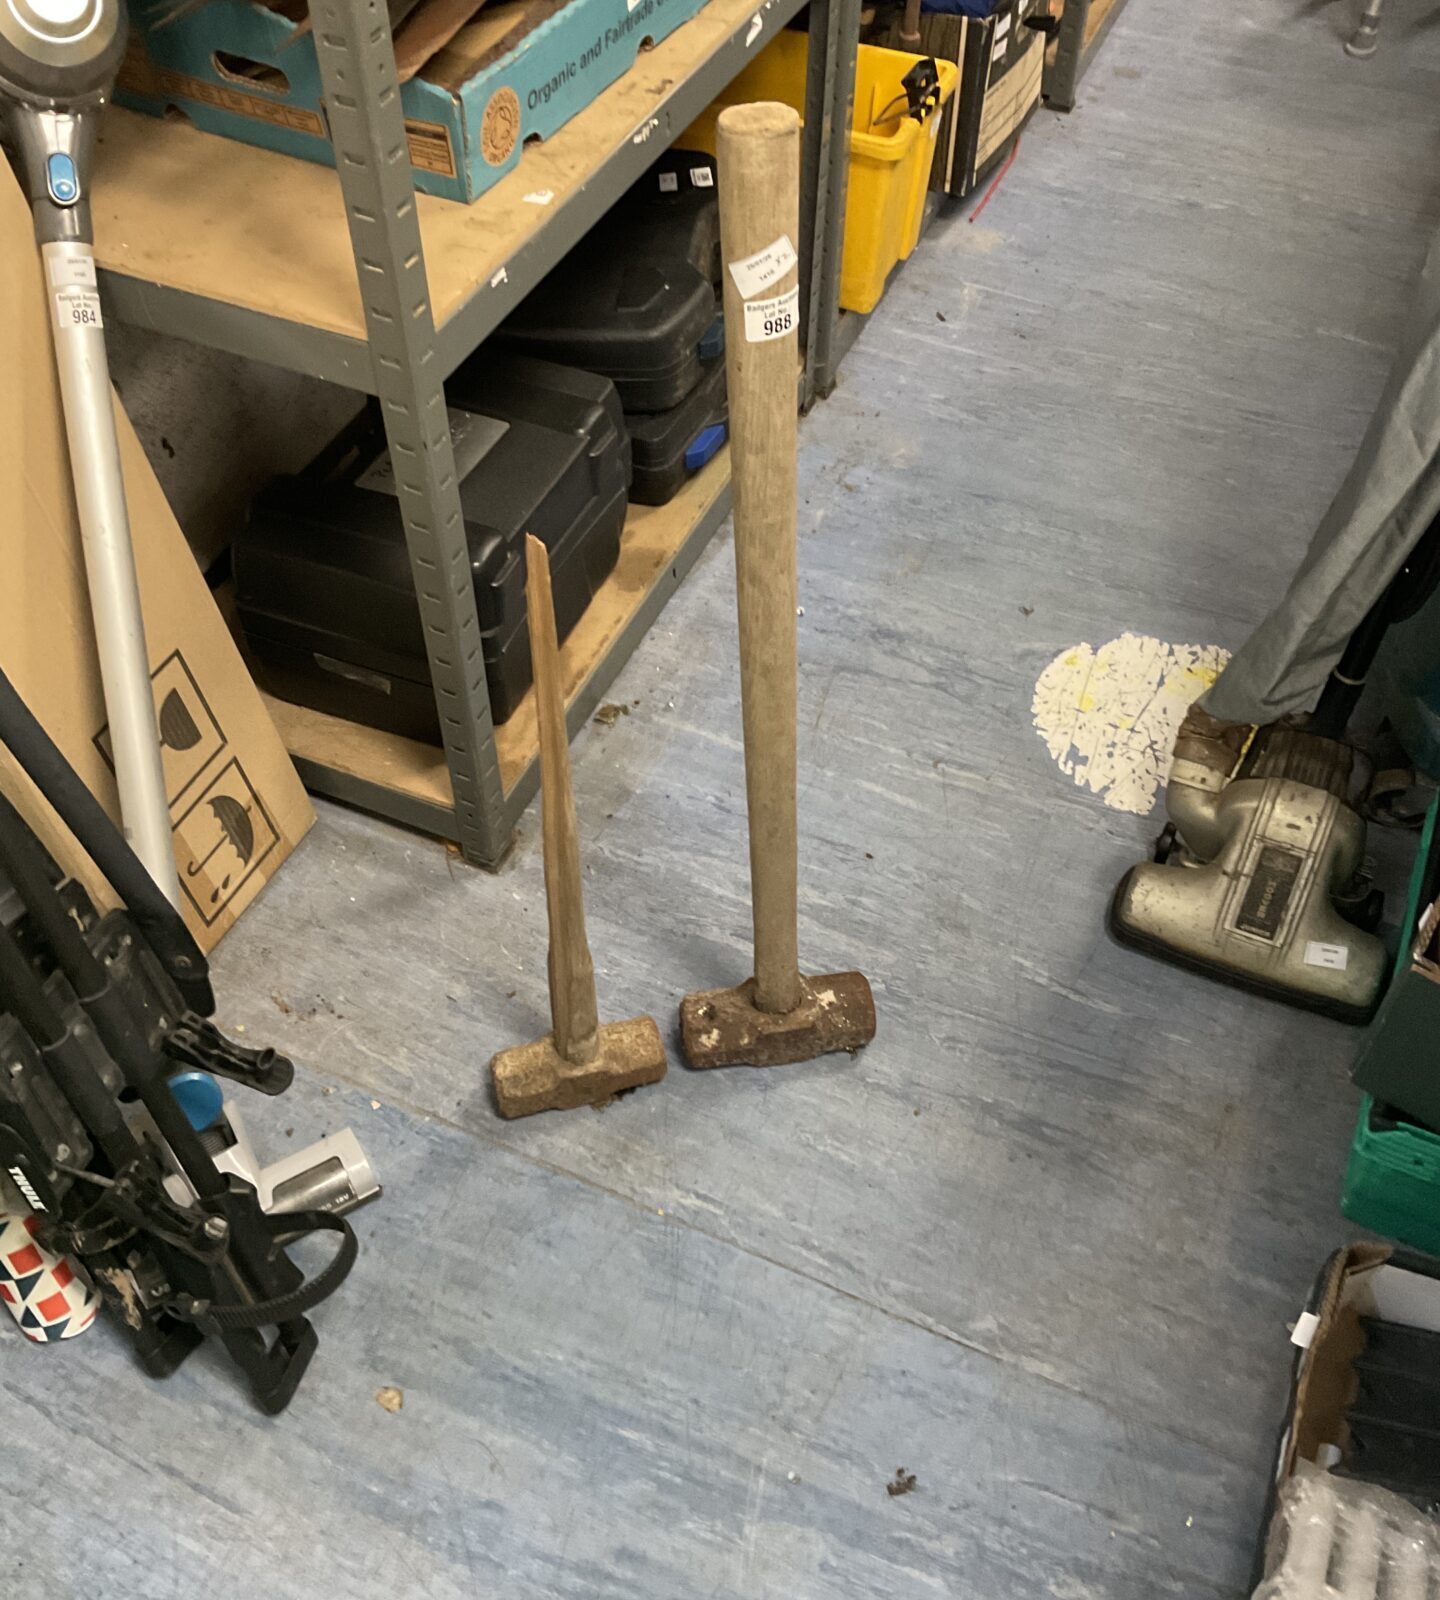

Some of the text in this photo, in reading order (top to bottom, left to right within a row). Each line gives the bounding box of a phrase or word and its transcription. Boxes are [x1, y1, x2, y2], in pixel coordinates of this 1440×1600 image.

[527, 1, 655, 111] Organic and Fairtrade
[72, 309, 97, 325] 984
[763, 313, 792, 336] 988
[764, 310, 775, 319] Lot
[7, 1166, 49, 1213] THULE
